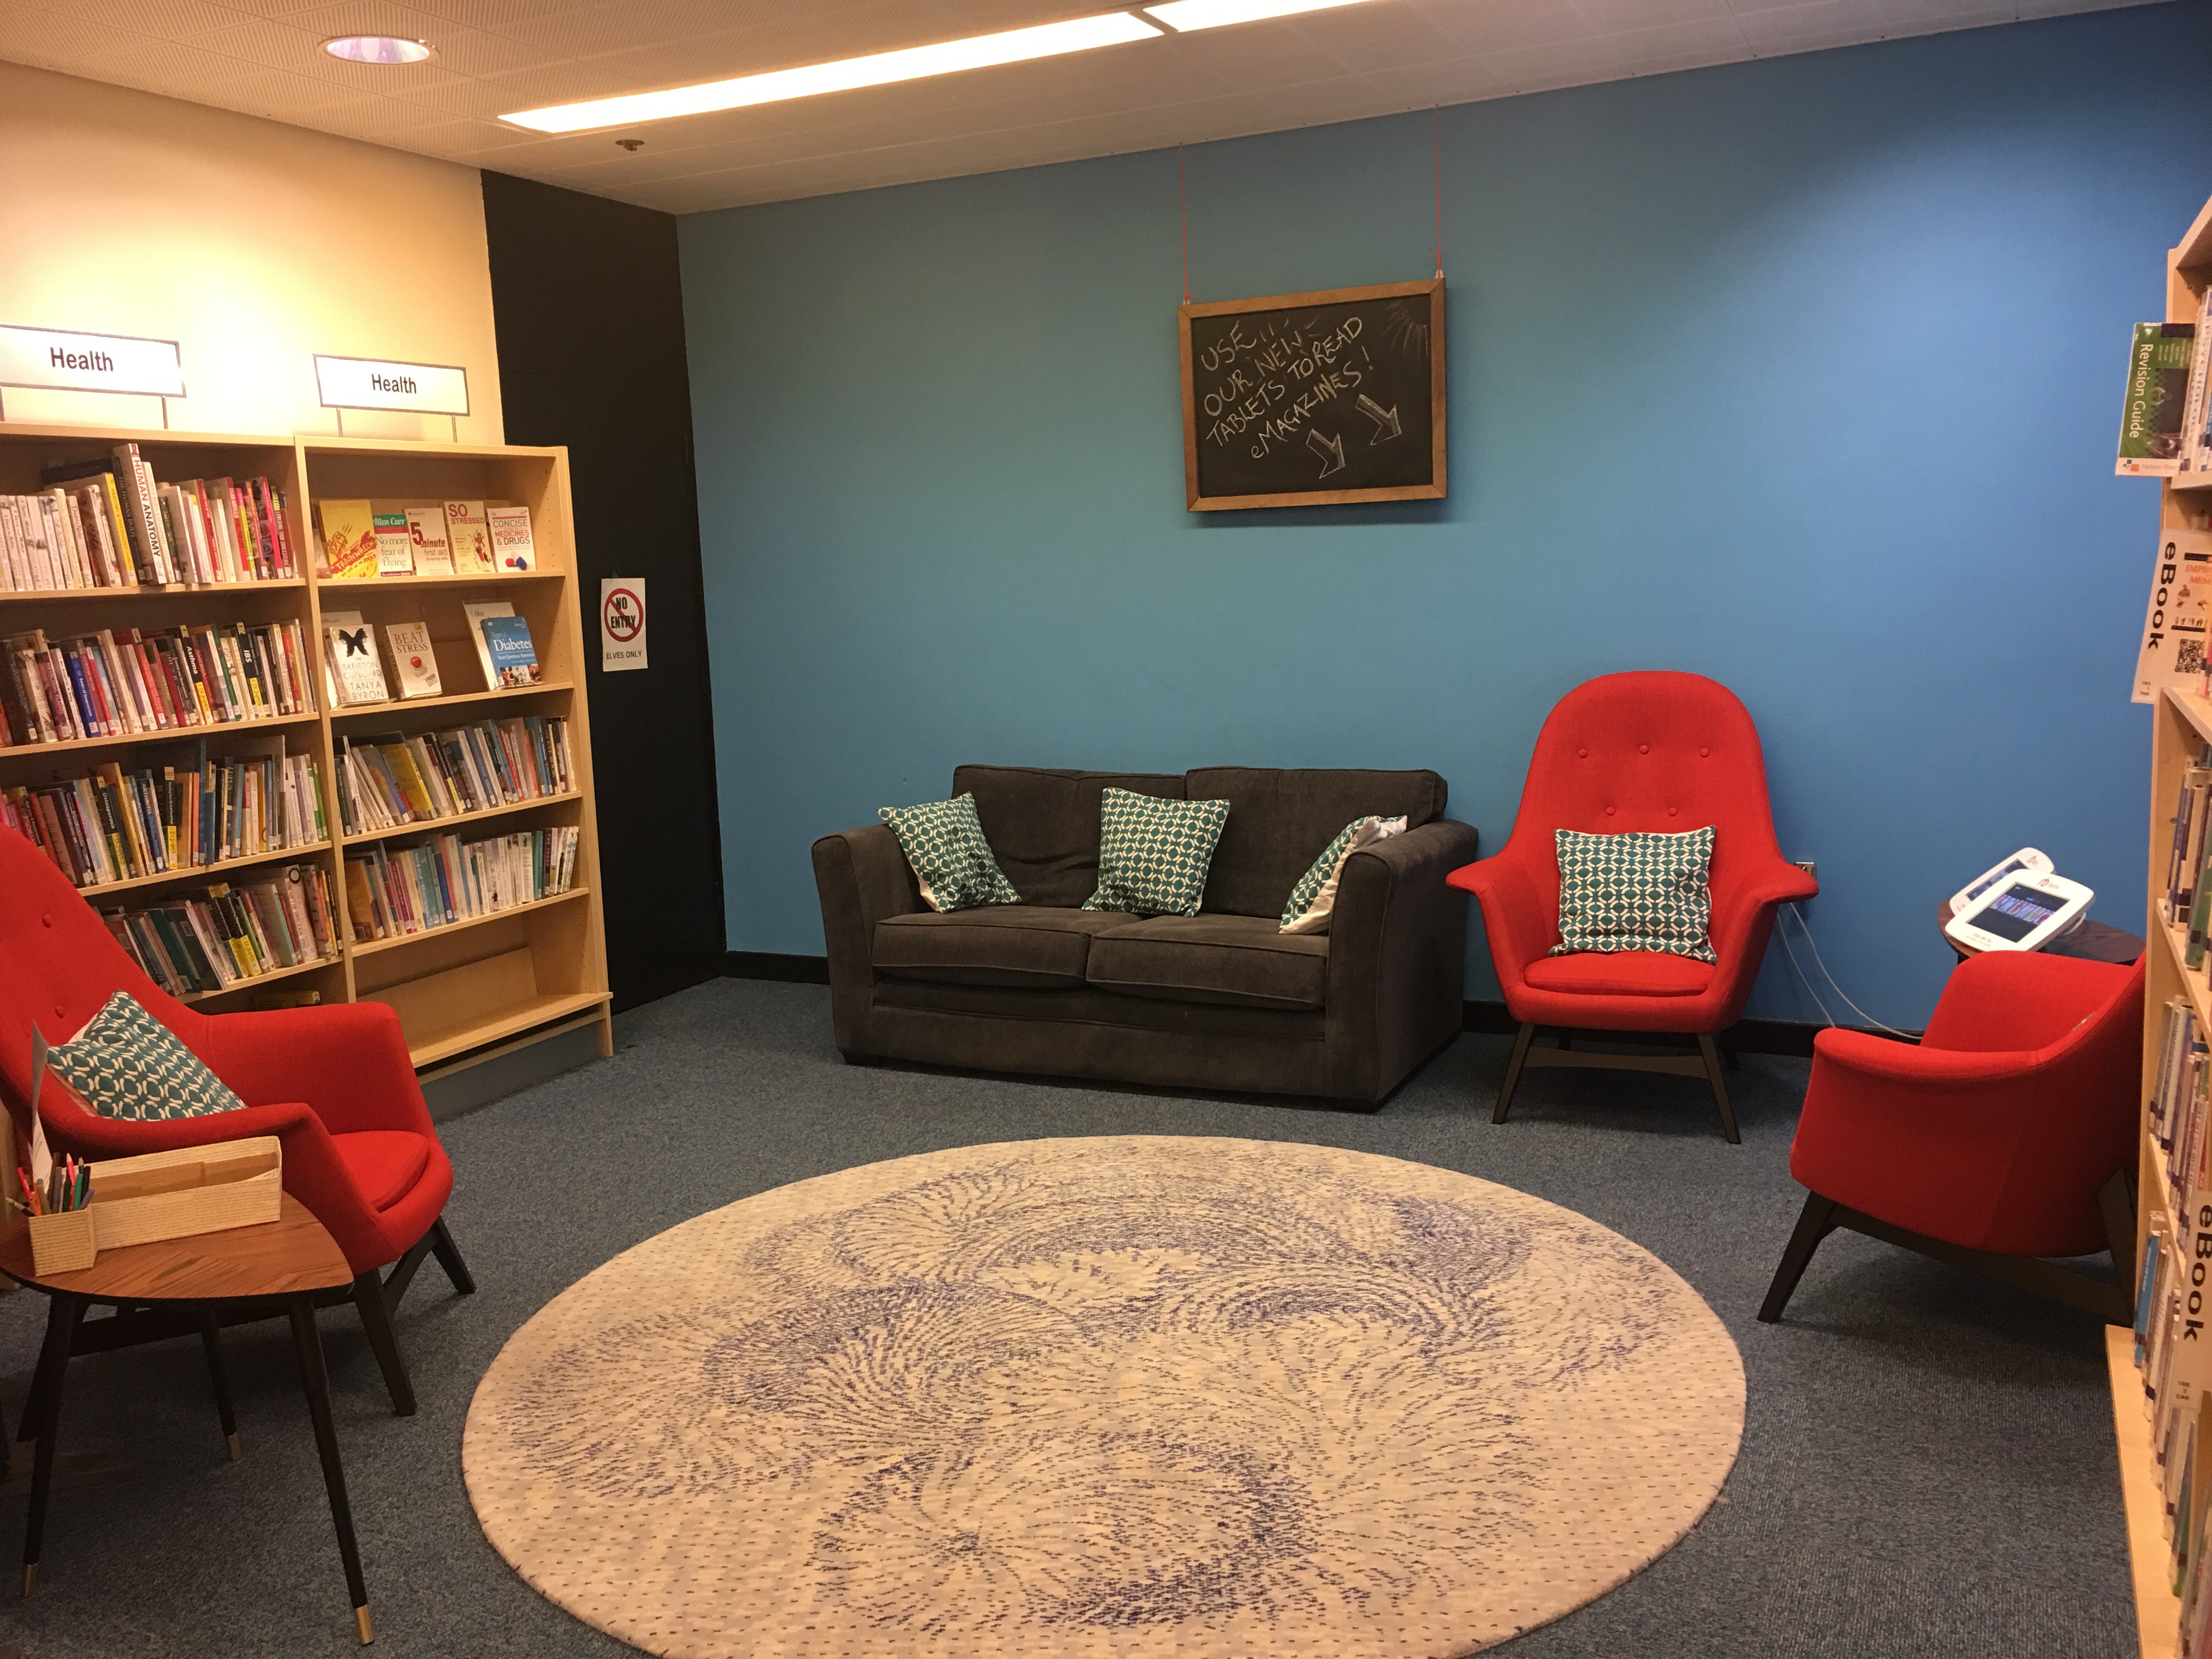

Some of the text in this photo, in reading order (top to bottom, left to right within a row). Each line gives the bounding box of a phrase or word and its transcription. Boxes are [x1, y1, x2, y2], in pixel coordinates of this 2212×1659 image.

[1201, 320, 1256, 371] USE
[50, 347, 114, 373] Health
[1204, 330, 1303, 416] OUR NEW
[371, 373, 417, 395] Health
[1206, 380, 1285, 447] TABLETS
[1312, 317, 1362, 366] READ
[2129, 343, 2154, 438] Revision Guide
[122, 490, 132, 517] HUMAN
[128, 518, 137, 538] BODY
[133, 459, 150, 501] HUMAN
[143, 504, 161, 557] ANATOMY
[231, 499, 239, 519] GRYLLS
[448, 504, 468, 517] SO
[207, 517, 216, 537] BRAIN
[391, 517, 405, 525] Carr
[494, 519, 528, 528] CONCISE
[375, 536, 388, 545] No
[410, 522, 423, 545] 5
[495, 529, 529, 538] MEDICINES
[503, 536, 531, 545] DRUGS
[381, 545, 405, 556] fear of
[421, 539, 445, 548] minute
[336, 540, 376, 571] TRAINWRECK
[383, 557, 407, 569] flying
[616, 596, 628, 610] NO
[2147, 541, 2177, 650] eBook
[611, 615, 636, 629] ENTRY
[393, 631, 425, 645] BEAT
[493, 638, 533, 651] Diabetes
[397, 642, 428, 654] STRESS
[606, 651, 624, 660] ELVES
[342, 662, 378, 671] SKELETON
[343, 669, 382, 680] CUPBOARD
[47, 662, 58, 693] MEDICINAL
[187, 646, 209, 712] Asthma DUMMIE
[243, 649, 263, 707] IBS DUMMIE
[349, 680, 382, 691] TANYA
[352, 690, 385, 701] BYRON
[142, 783, 152, 815] ARTHRITIS
[103, 792, 115, 830] Osteoporosis
[2183, 1204, 2212, 1342] eBook
